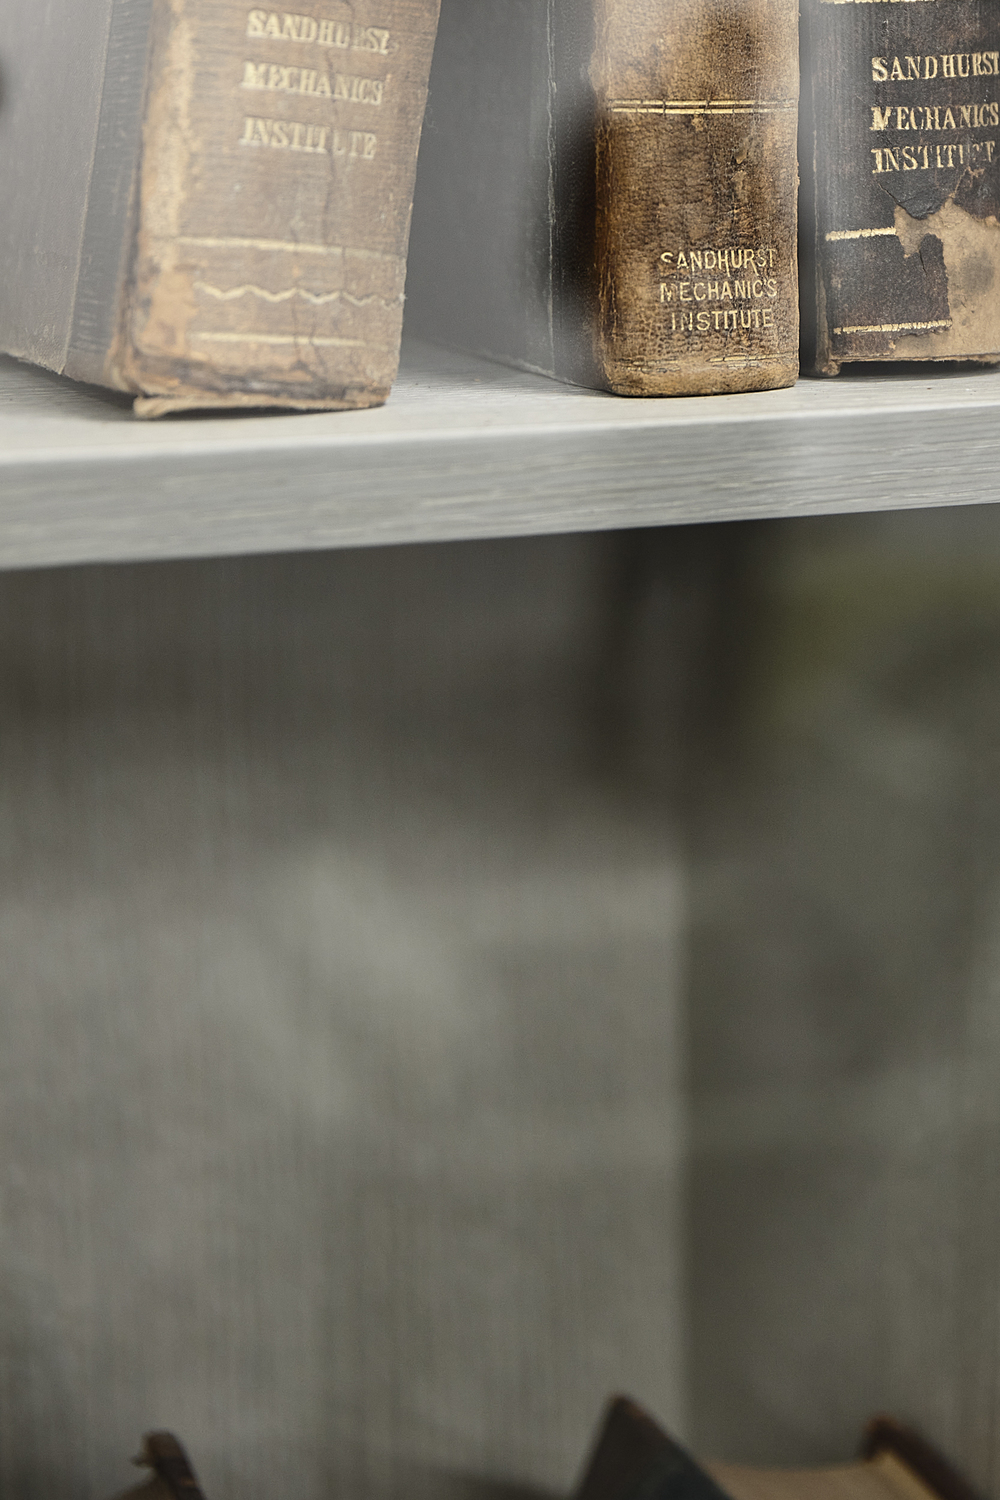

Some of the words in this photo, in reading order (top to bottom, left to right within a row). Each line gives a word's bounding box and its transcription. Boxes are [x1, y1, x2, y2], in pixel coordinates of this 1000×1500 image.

[871, 50, 1000, 82] SANDHURST
[868, 100, 1000, 132] MECHANICS
[660, 248, 778, 278] SANDHURST
[671, 308, 775, 332] INSTITUTE
